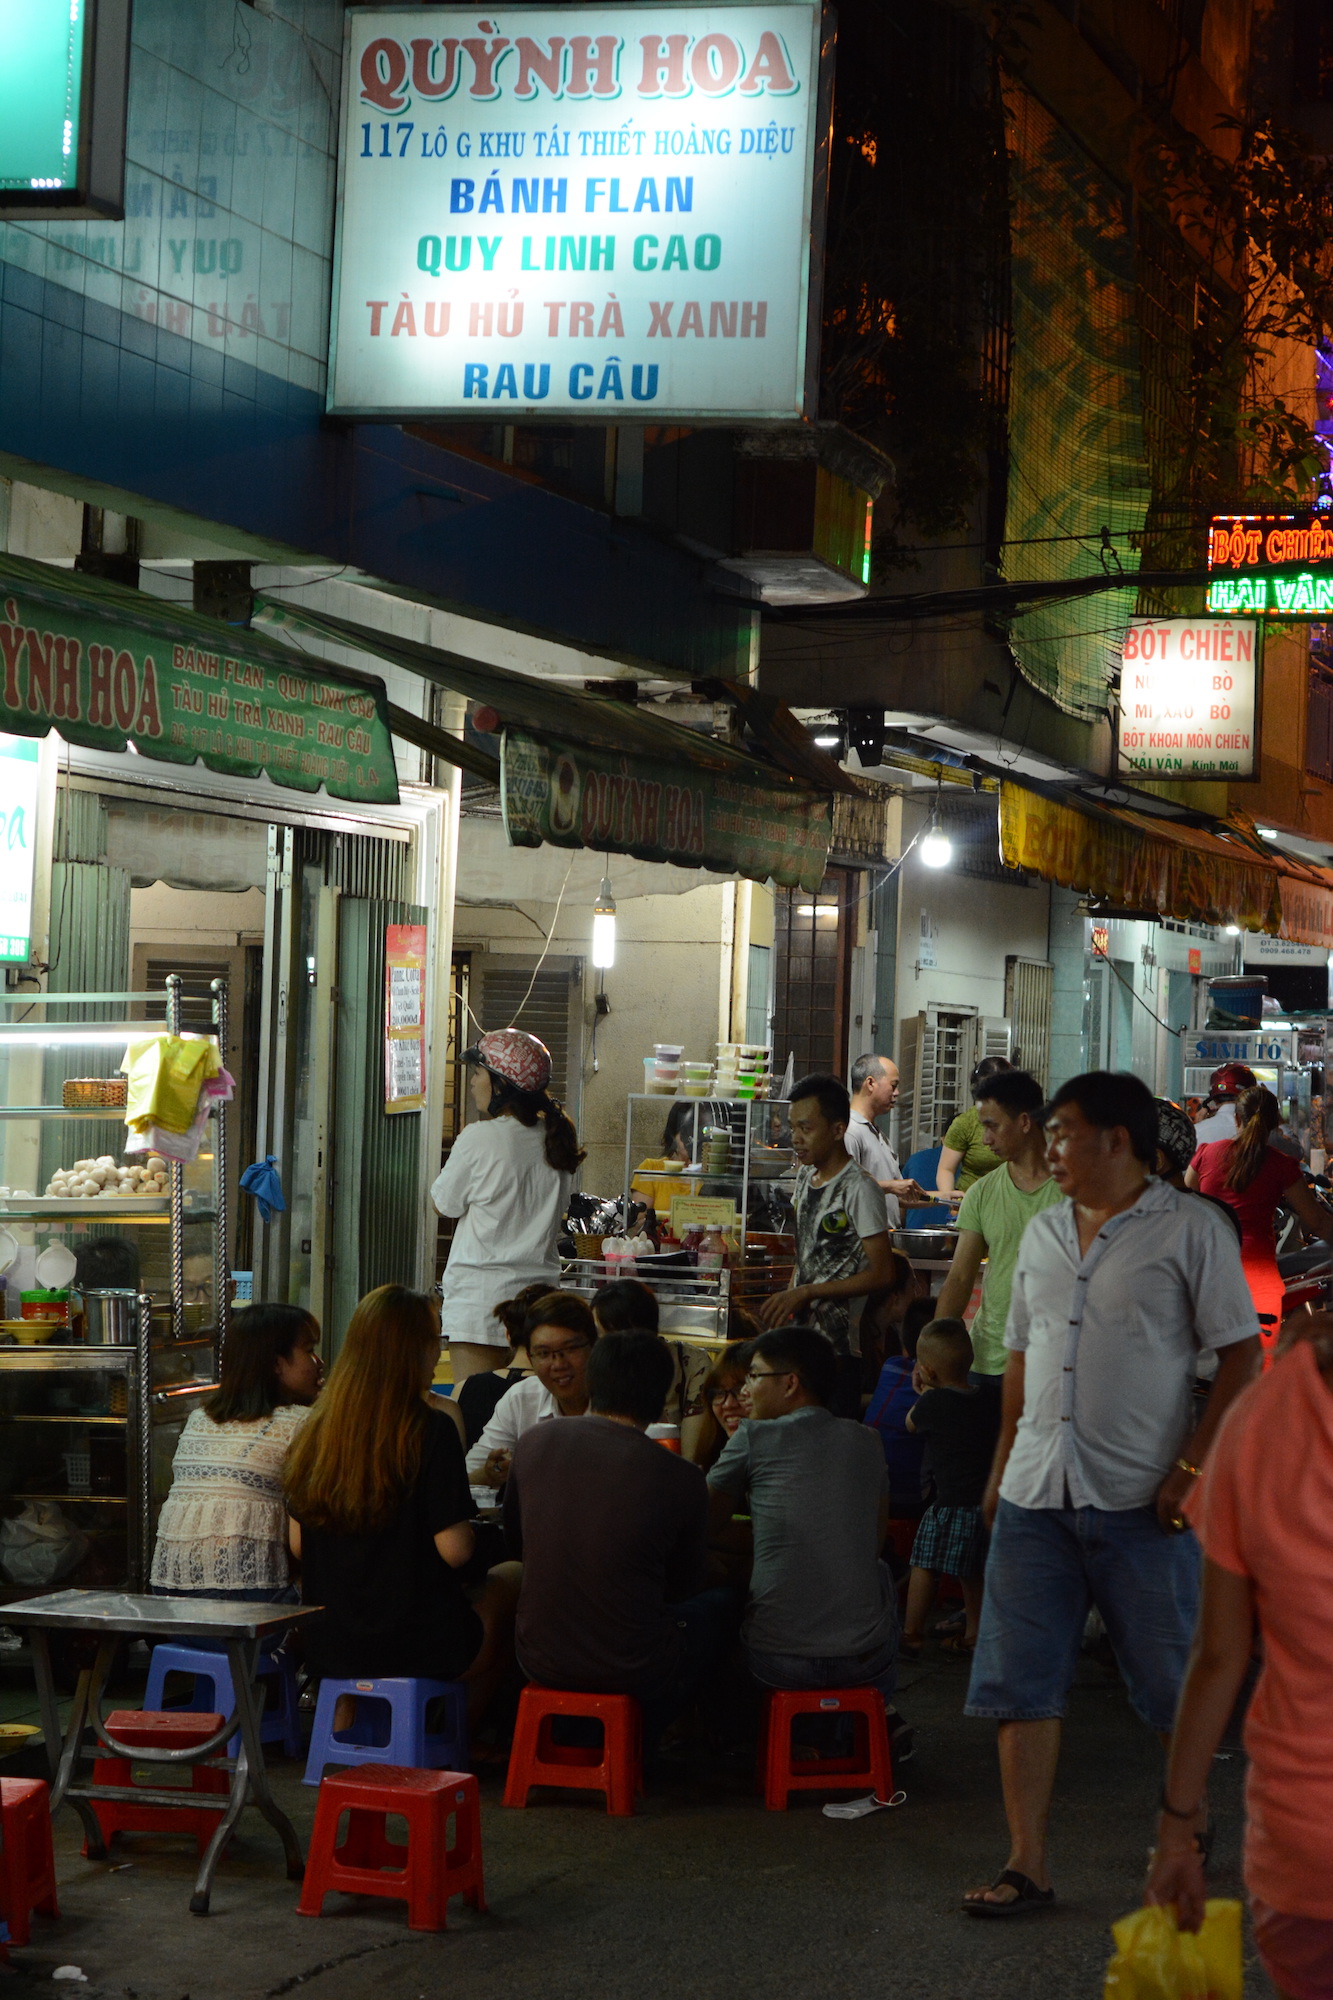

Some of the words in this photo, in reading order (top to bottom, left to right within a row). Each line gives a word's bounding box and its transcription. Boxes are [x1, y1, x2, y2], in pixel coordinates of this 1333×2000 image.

[360, 20, 623, 115] QUỲNH
[636, 31, 800, 98] HOA
[360, 122, 414, 158] 117
[421, 126, 448, 158] LÔ
[456, 133, 472, 158] G
[478, 132, 525, 157] KHU
[533, 123, 570, 157] TÁI
[578, 118, 646, 156] THIẾT
[654, 123, 731, 156] HOÀNG
[739, 120, 795, 160] DIỆU
[449, 169, 568, 214] BÁNH
[584, 176, 694, 213] FLAN
[416, 234, 503, 277] QUY
[520, 234, 616, 271] LINH
[632, 233, 722, 272] CAO
[365, 291, 451, 338] TÀU
[467, 287, 525, 338] HỦ
[543, 291, 626, 338] TRÀ
[646, 300, 768, 338] XANH
[463, 362, 551, 399] RAU
[568, 356, 659, 401] CÂU
[1213, 519, 1263, 569] BỘT
[1274, 573, 1333, 608] VÂN
[1124, 619, 1171, 665] BỘT
[1180, 621, 1252, 662] CHIÊN
[87, 642, 164, 739] HOA
[172, 643, 219, 679] BÁNH
[223, 658, 264, 691] FLAN
[278, 673, 308, 703] QUY
[311, 682, 344, 712] LINH
[347, 692, 376, 720] CAO
[1212, 669, 1233, 691] BÒ
[171, 679, 203, 715] TÀU
[207, 687, 229, 720] HỦ
[233, 698, 263, 729] TRÀ
[266, 708, 305, 739] XANH
[317, 721, 344, 750] RAU
[347, 725, 372, 755] CÂU
[1210, 697, 1231, 720] BÒ
[190, 726, 207, 751] 117
[226, 733, 233, 757] G
[236, 736, 254, 761] KHU
[1123, 727, 1145, 751] BỘT
[1149, 733, 1183, 749] KHOAI
[1186, 727, 1212, 749] MÔN
[1215, 728, 1250, 750] CHIÊN
[1156, 753, 1182, 769] VÂN
[1192, 759, 1215, 770] Kính
[581, 757, 662, 847] QUỲNH
[665, 784, 706, 855] HOA
[1195, 1040, 1248, 1059] SINH
